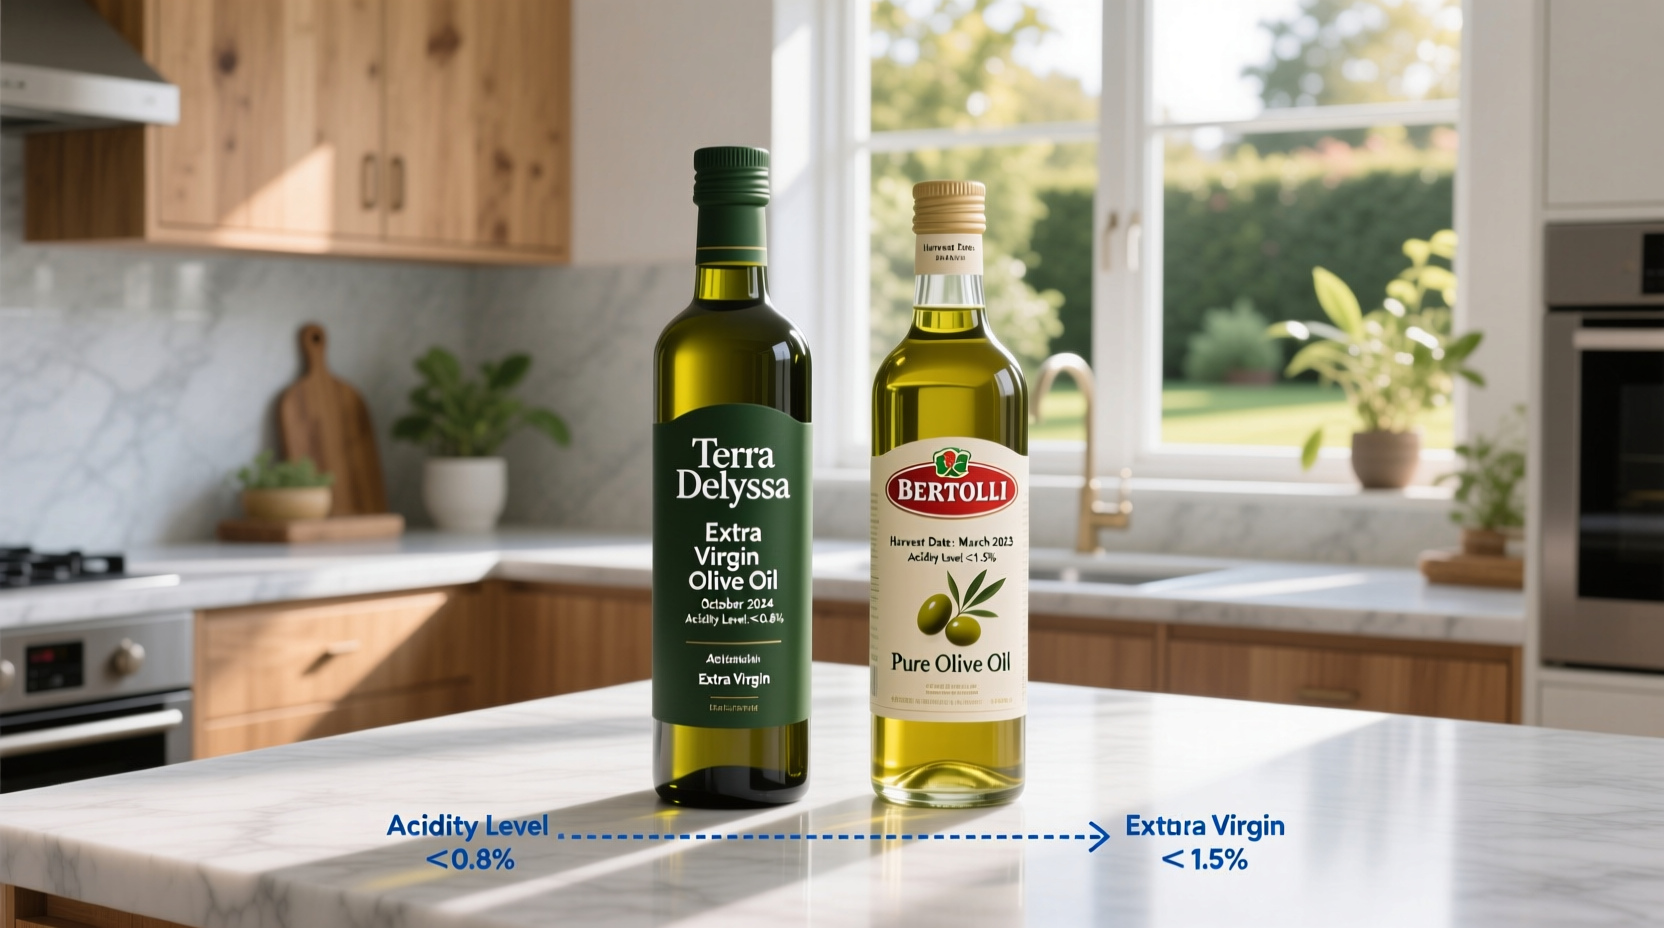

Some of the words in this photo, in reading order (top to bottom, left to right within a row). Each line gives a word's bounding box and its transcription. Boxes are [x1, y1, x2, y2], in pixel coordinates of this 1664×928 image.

[691, 437, 776, 469] Terra
[676, 469, 791, 509] Delyssa
[897, 478, 1008, 503] BERTOLLI
[705, 522, 762, 542] Extra
[890, 535, 926, 548] Harvest
[958, 536, 991, 548] March
[694, 546, 759, 571] Virgin
[688, 570, 745, 591] Olive
[749, 569, 778, 591] Oil
[746, 598, 775, 610] 2024
[891, 652, 931, 672] Pure
[935, 653, 983, 673] Olive
[987, 651, 1011, 672] Oil
[698, 672, 731, 686] Extra
[733, 672, 771, 689] Virgin
